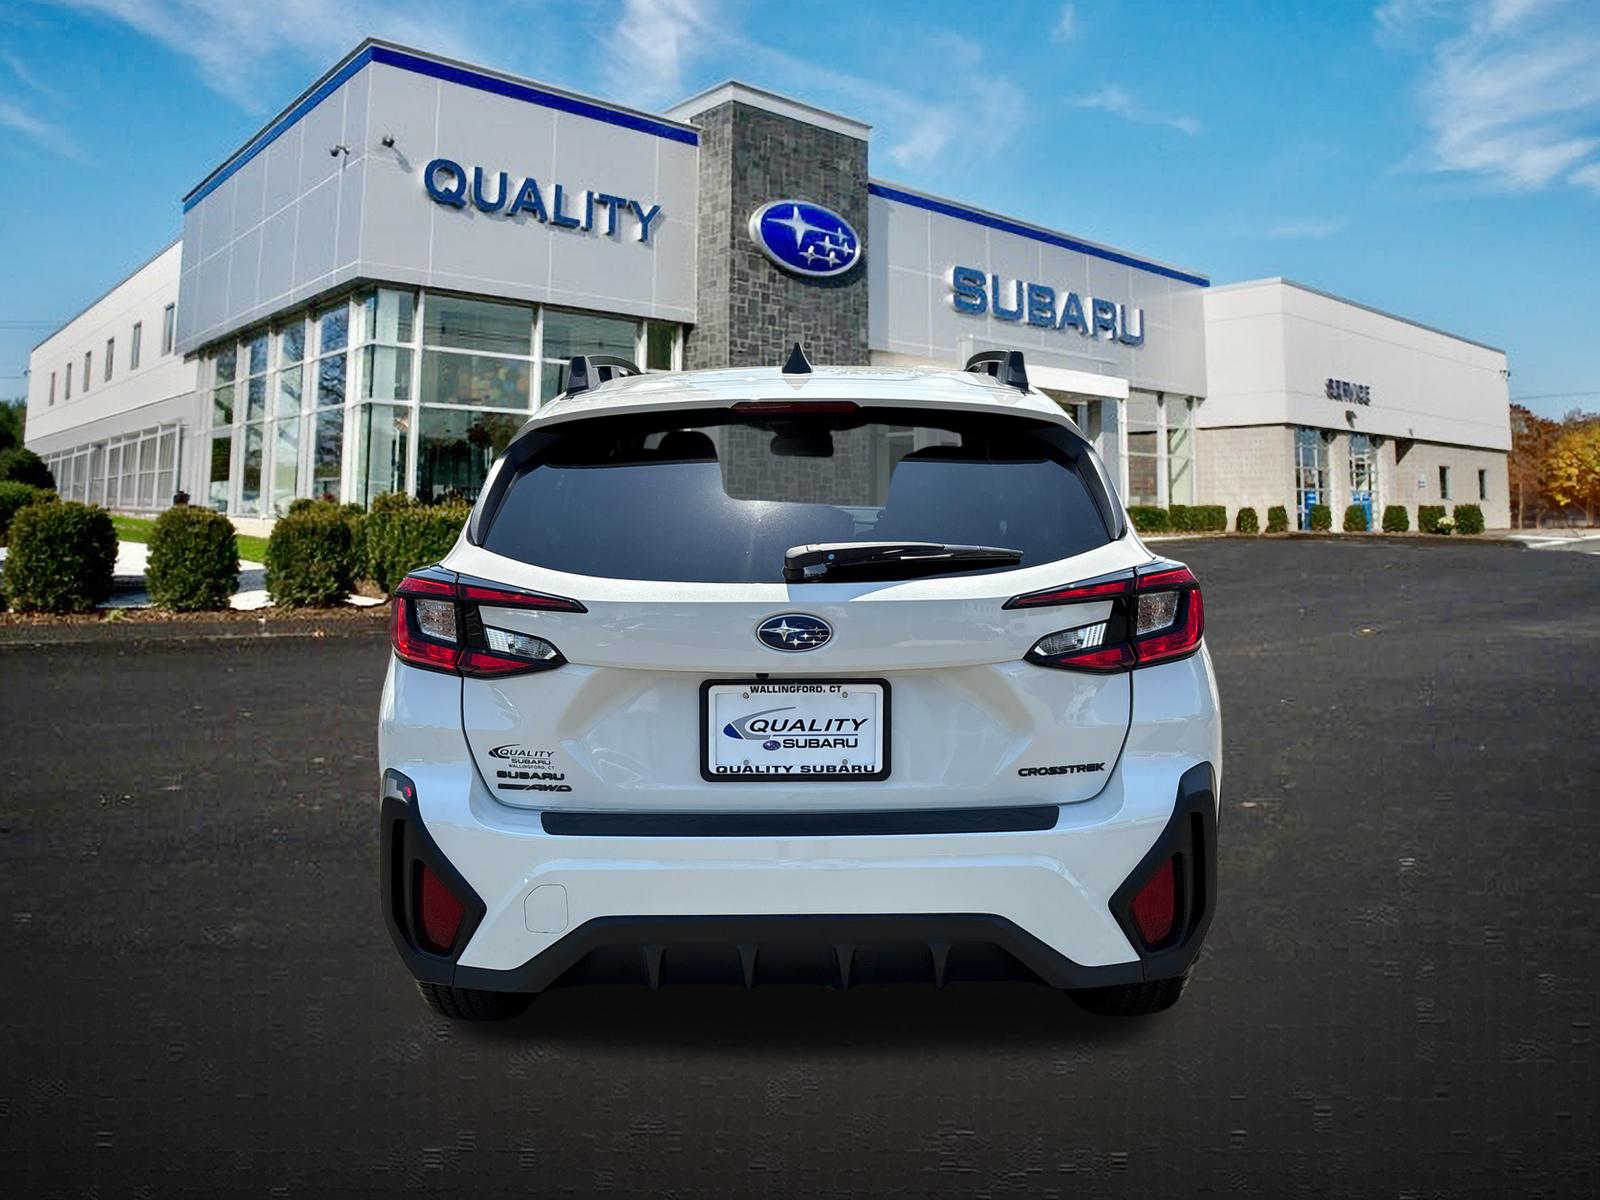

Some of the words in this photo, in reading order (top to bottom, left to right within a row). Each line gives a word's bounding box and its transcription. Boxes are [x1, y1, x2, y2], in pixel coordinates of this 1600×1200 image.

[424, 158, 662, 242] QUALITY
[952, 265, 1145, 347] SUBARU
[829, 685, 842, 693] CT
[749, 718, 869, 733] QUALITY
[782, 738, 859, 749] SUBARU
[500, 748, 554, 757] QUALITY
[715, 765, 794, 774] QUALITY
[800, 765, 876, 773] SUBARU
[1018, 762, 1105, 777] CROSSTREK
[496, 770, 565, 781] SUBARU
[525, 784, 573, 792] AWD
